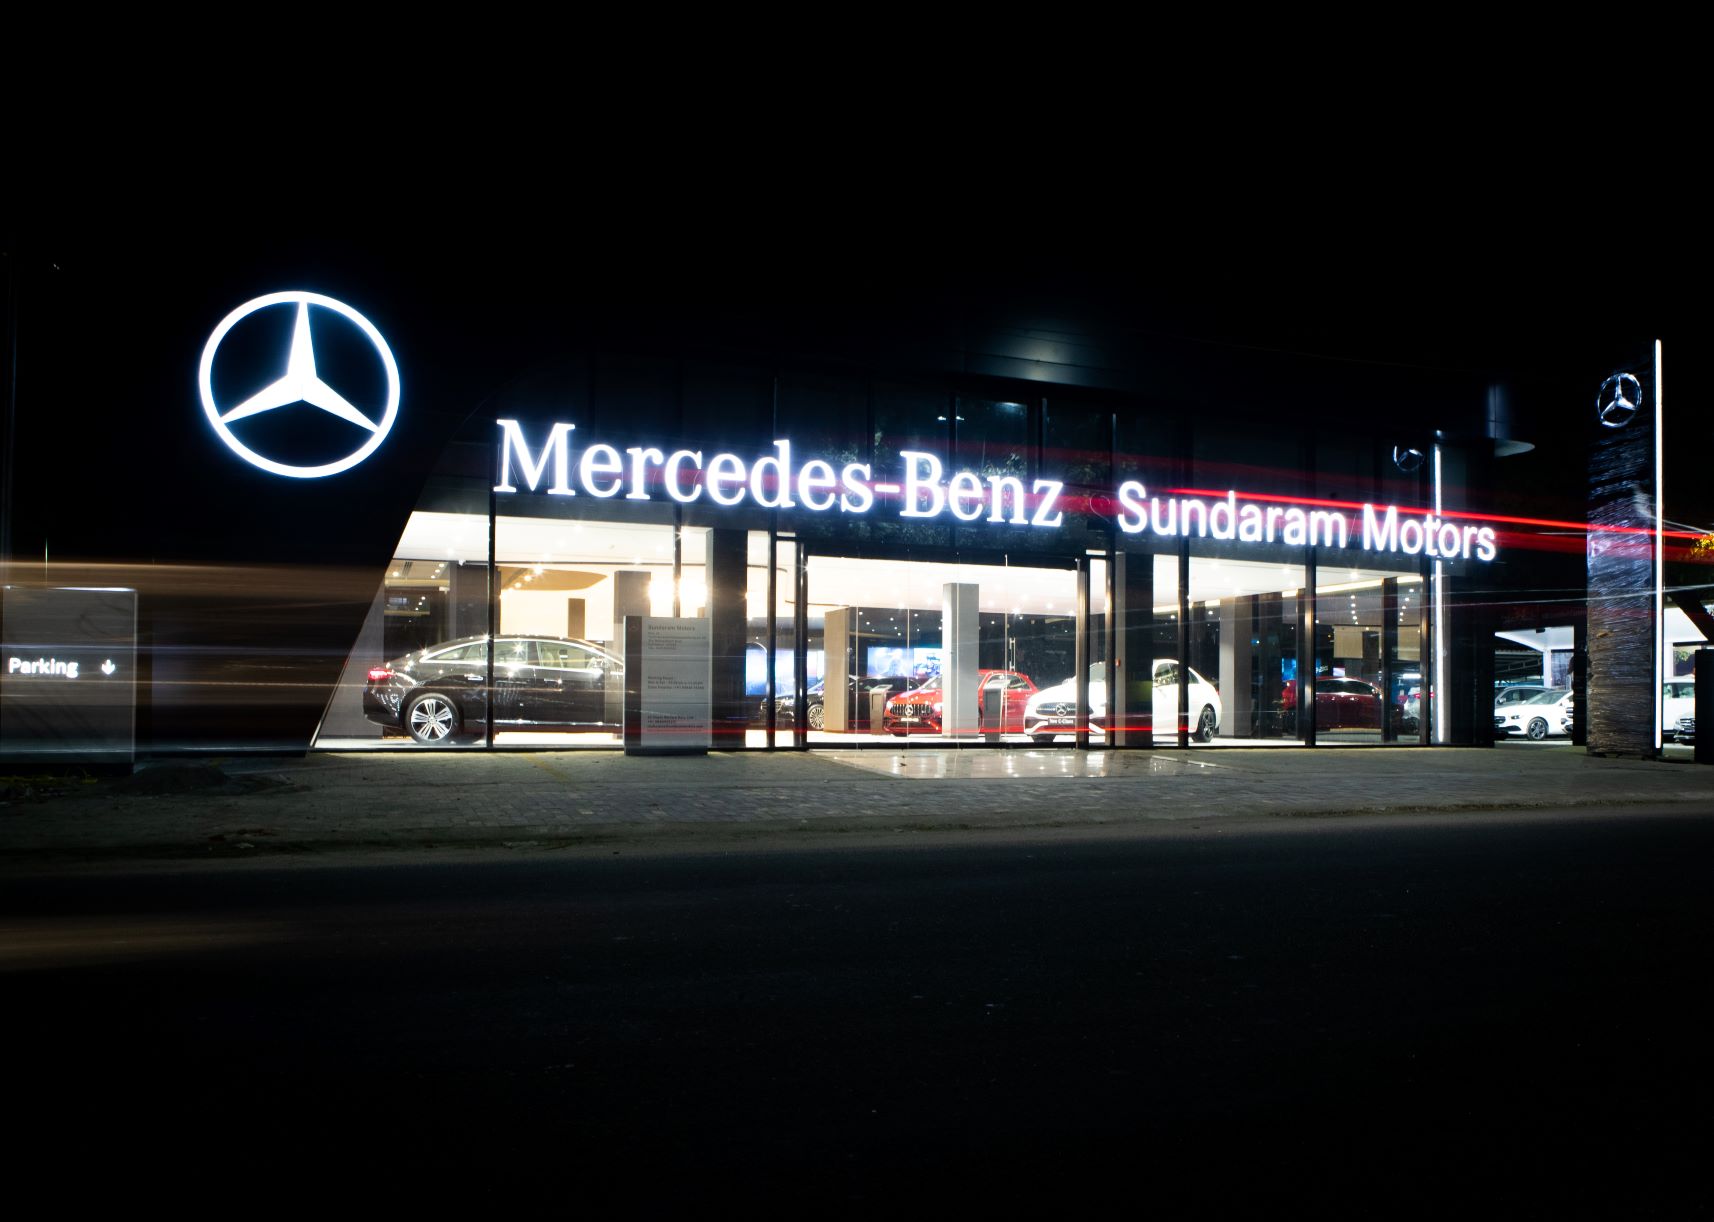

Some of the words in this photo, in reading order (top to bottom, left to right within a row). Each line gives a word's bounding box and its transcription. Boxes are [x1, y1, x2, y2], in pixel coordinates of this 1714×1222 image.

[494, 418, 1064, 528] Mercedes-Benz
[1117, 480, 1347, 548] Sundaram
[1362, 503, 1497, 562] Motors
[9, 657, 79, 678] Parking
